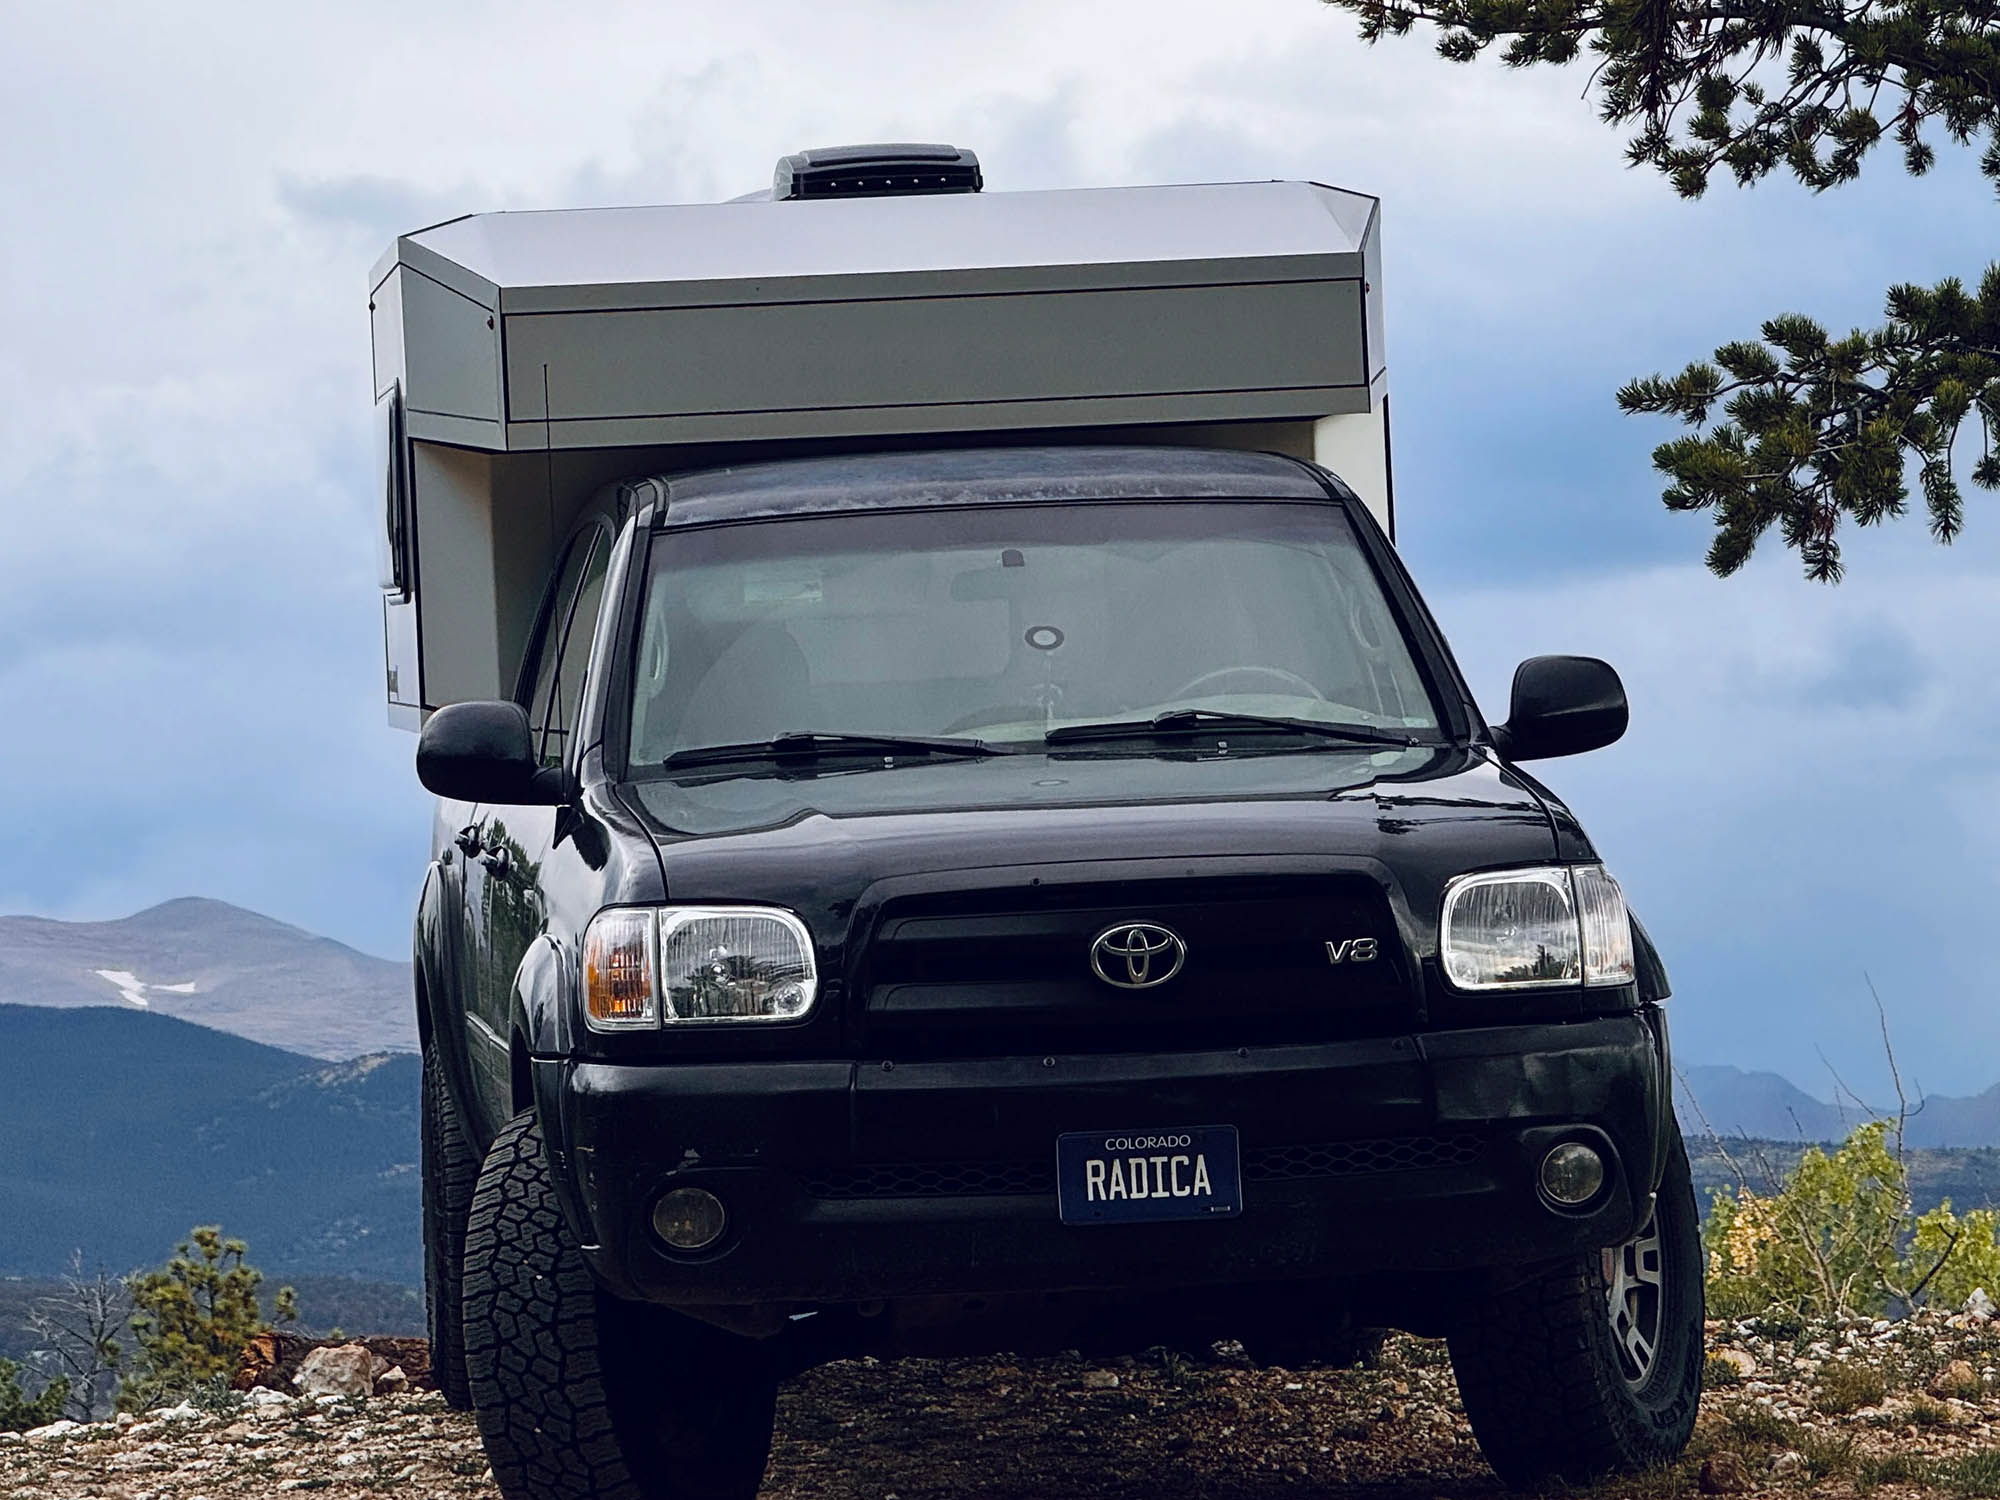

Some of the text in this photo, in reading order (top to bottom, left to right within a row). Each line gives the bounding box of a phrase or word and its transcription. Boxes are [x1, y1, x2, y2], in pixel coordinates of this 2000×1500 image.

[1326, 938, 1378, 964] V8
[1105, 1134, 1191, 1151] COLORADO
[1086, 1154, 1212, 1201] RADICA
